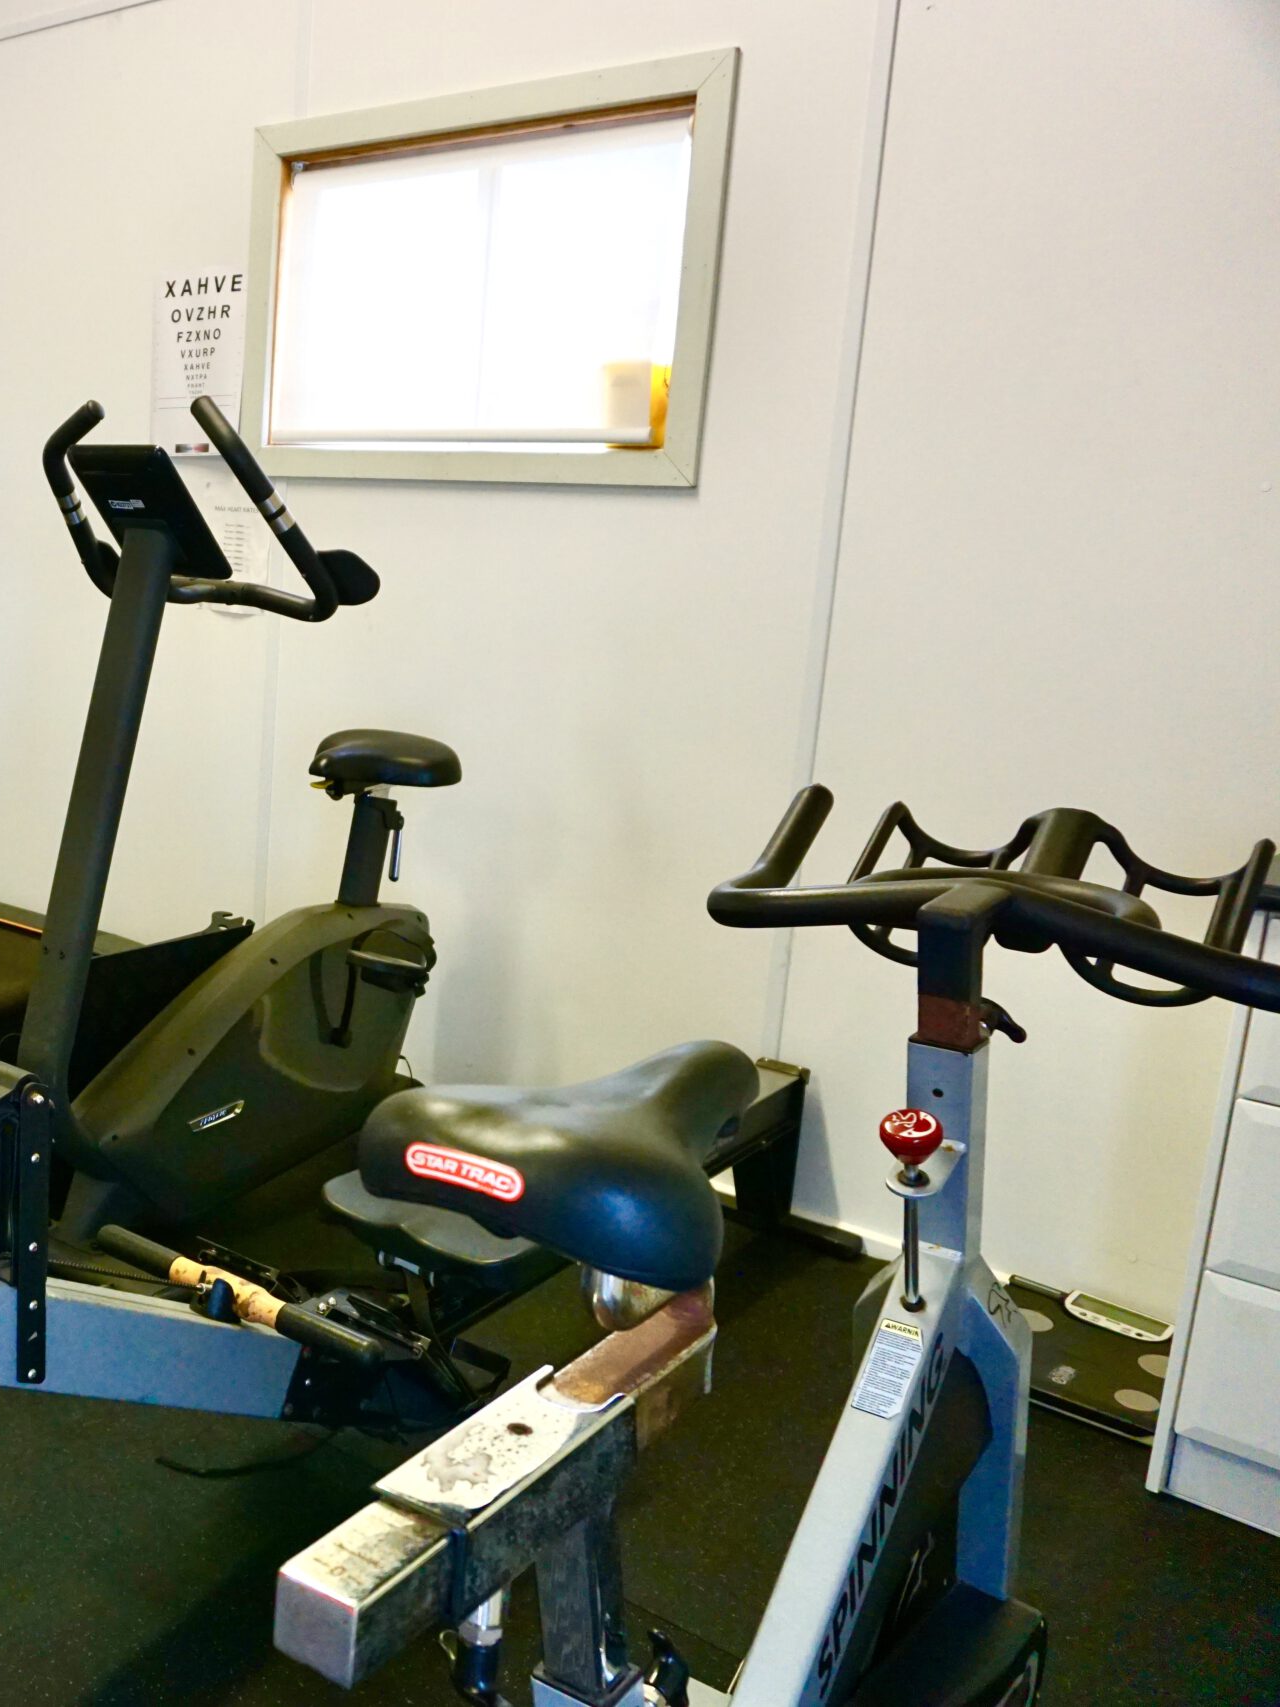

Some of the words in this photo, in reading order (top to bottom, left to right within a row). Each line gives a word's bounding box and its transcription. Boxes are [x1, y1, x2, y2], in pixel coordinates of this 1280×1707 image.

[165, 274, 243, 298] XAHVE
[171, 304, 231, 323] OVZHR
[177, 328, 221, 342] FZXNO
[180, 347, 216, 359] VXURP
[412, 1152, 459, 1173] STAR
[460, 1163, 513, 1190] TRAC
[818, 1332, 945, 1699] SPINNING
